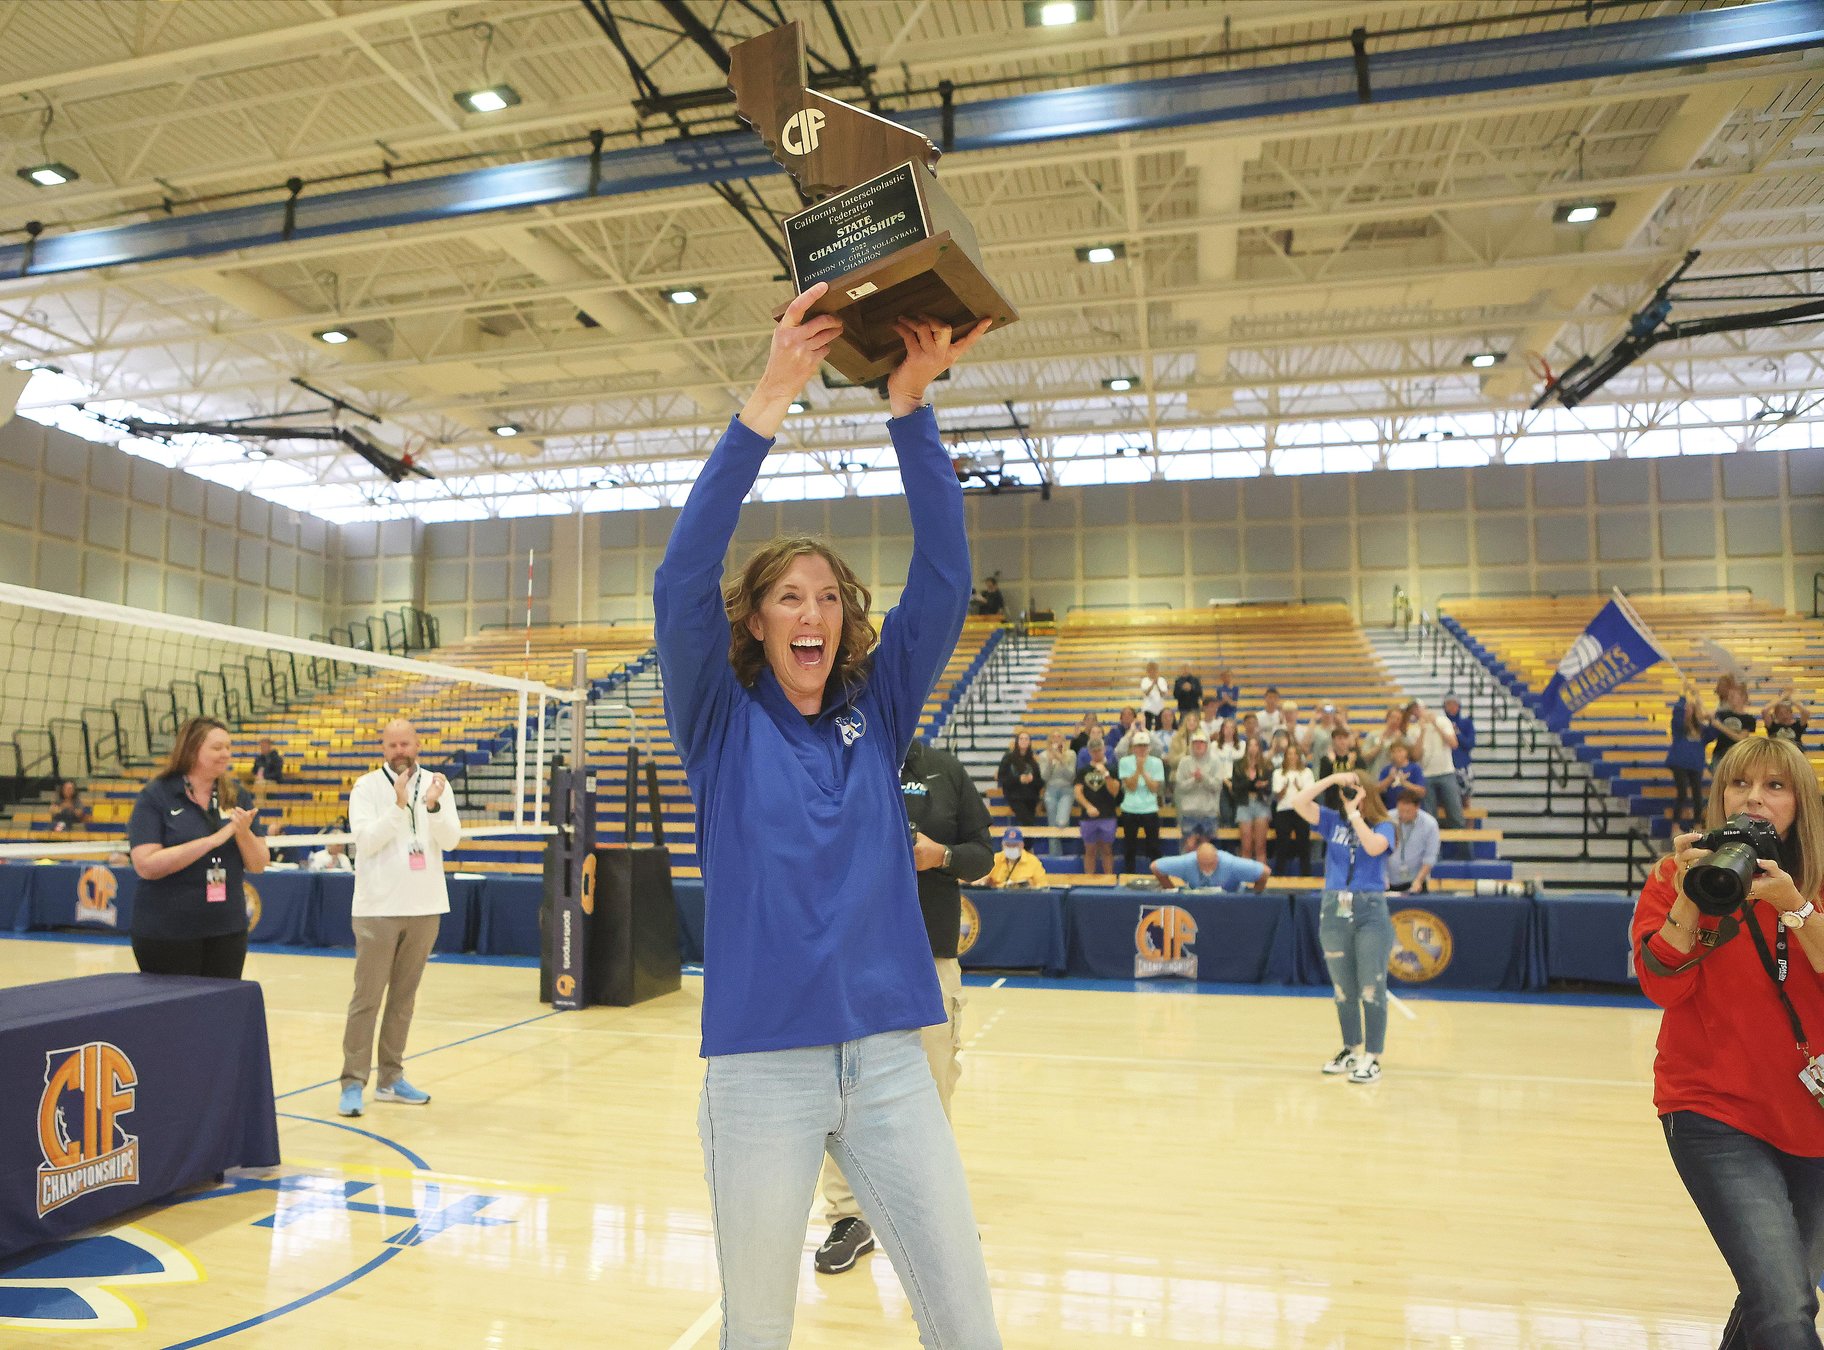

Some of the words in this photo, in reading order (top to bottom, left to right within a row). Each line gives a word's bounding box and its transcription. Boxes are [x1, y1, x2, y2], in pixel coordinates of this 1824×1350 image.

[781, 108, 826, 155] CIF
[794, 206, 836, 230] California
[840, 173, 905, 208] Interscholastic
[829, 199, 874, 225] Federation
[836, 215, 873, 238] STATE
[804, 264, 836, 282] DIVISION
[838, 259, 846, 267] IV
[848, 249, 870, 262] GIRLS
[872, 226, 919, 250] VOLLEYBALL
[809, 211, 906, 261] CHAMPIONSHIPS
[843, 250, 881, 272] CHAMPION
[850, 242, 867, 253] 2022
[1560, 645, 1630, 704] KNIGHTS
[1136, 905, 1198, 961] CIF
[39, 1043, 137, 1168] CIF
[42, 1150, 134, 1206] CHAMPIONSHIPS
